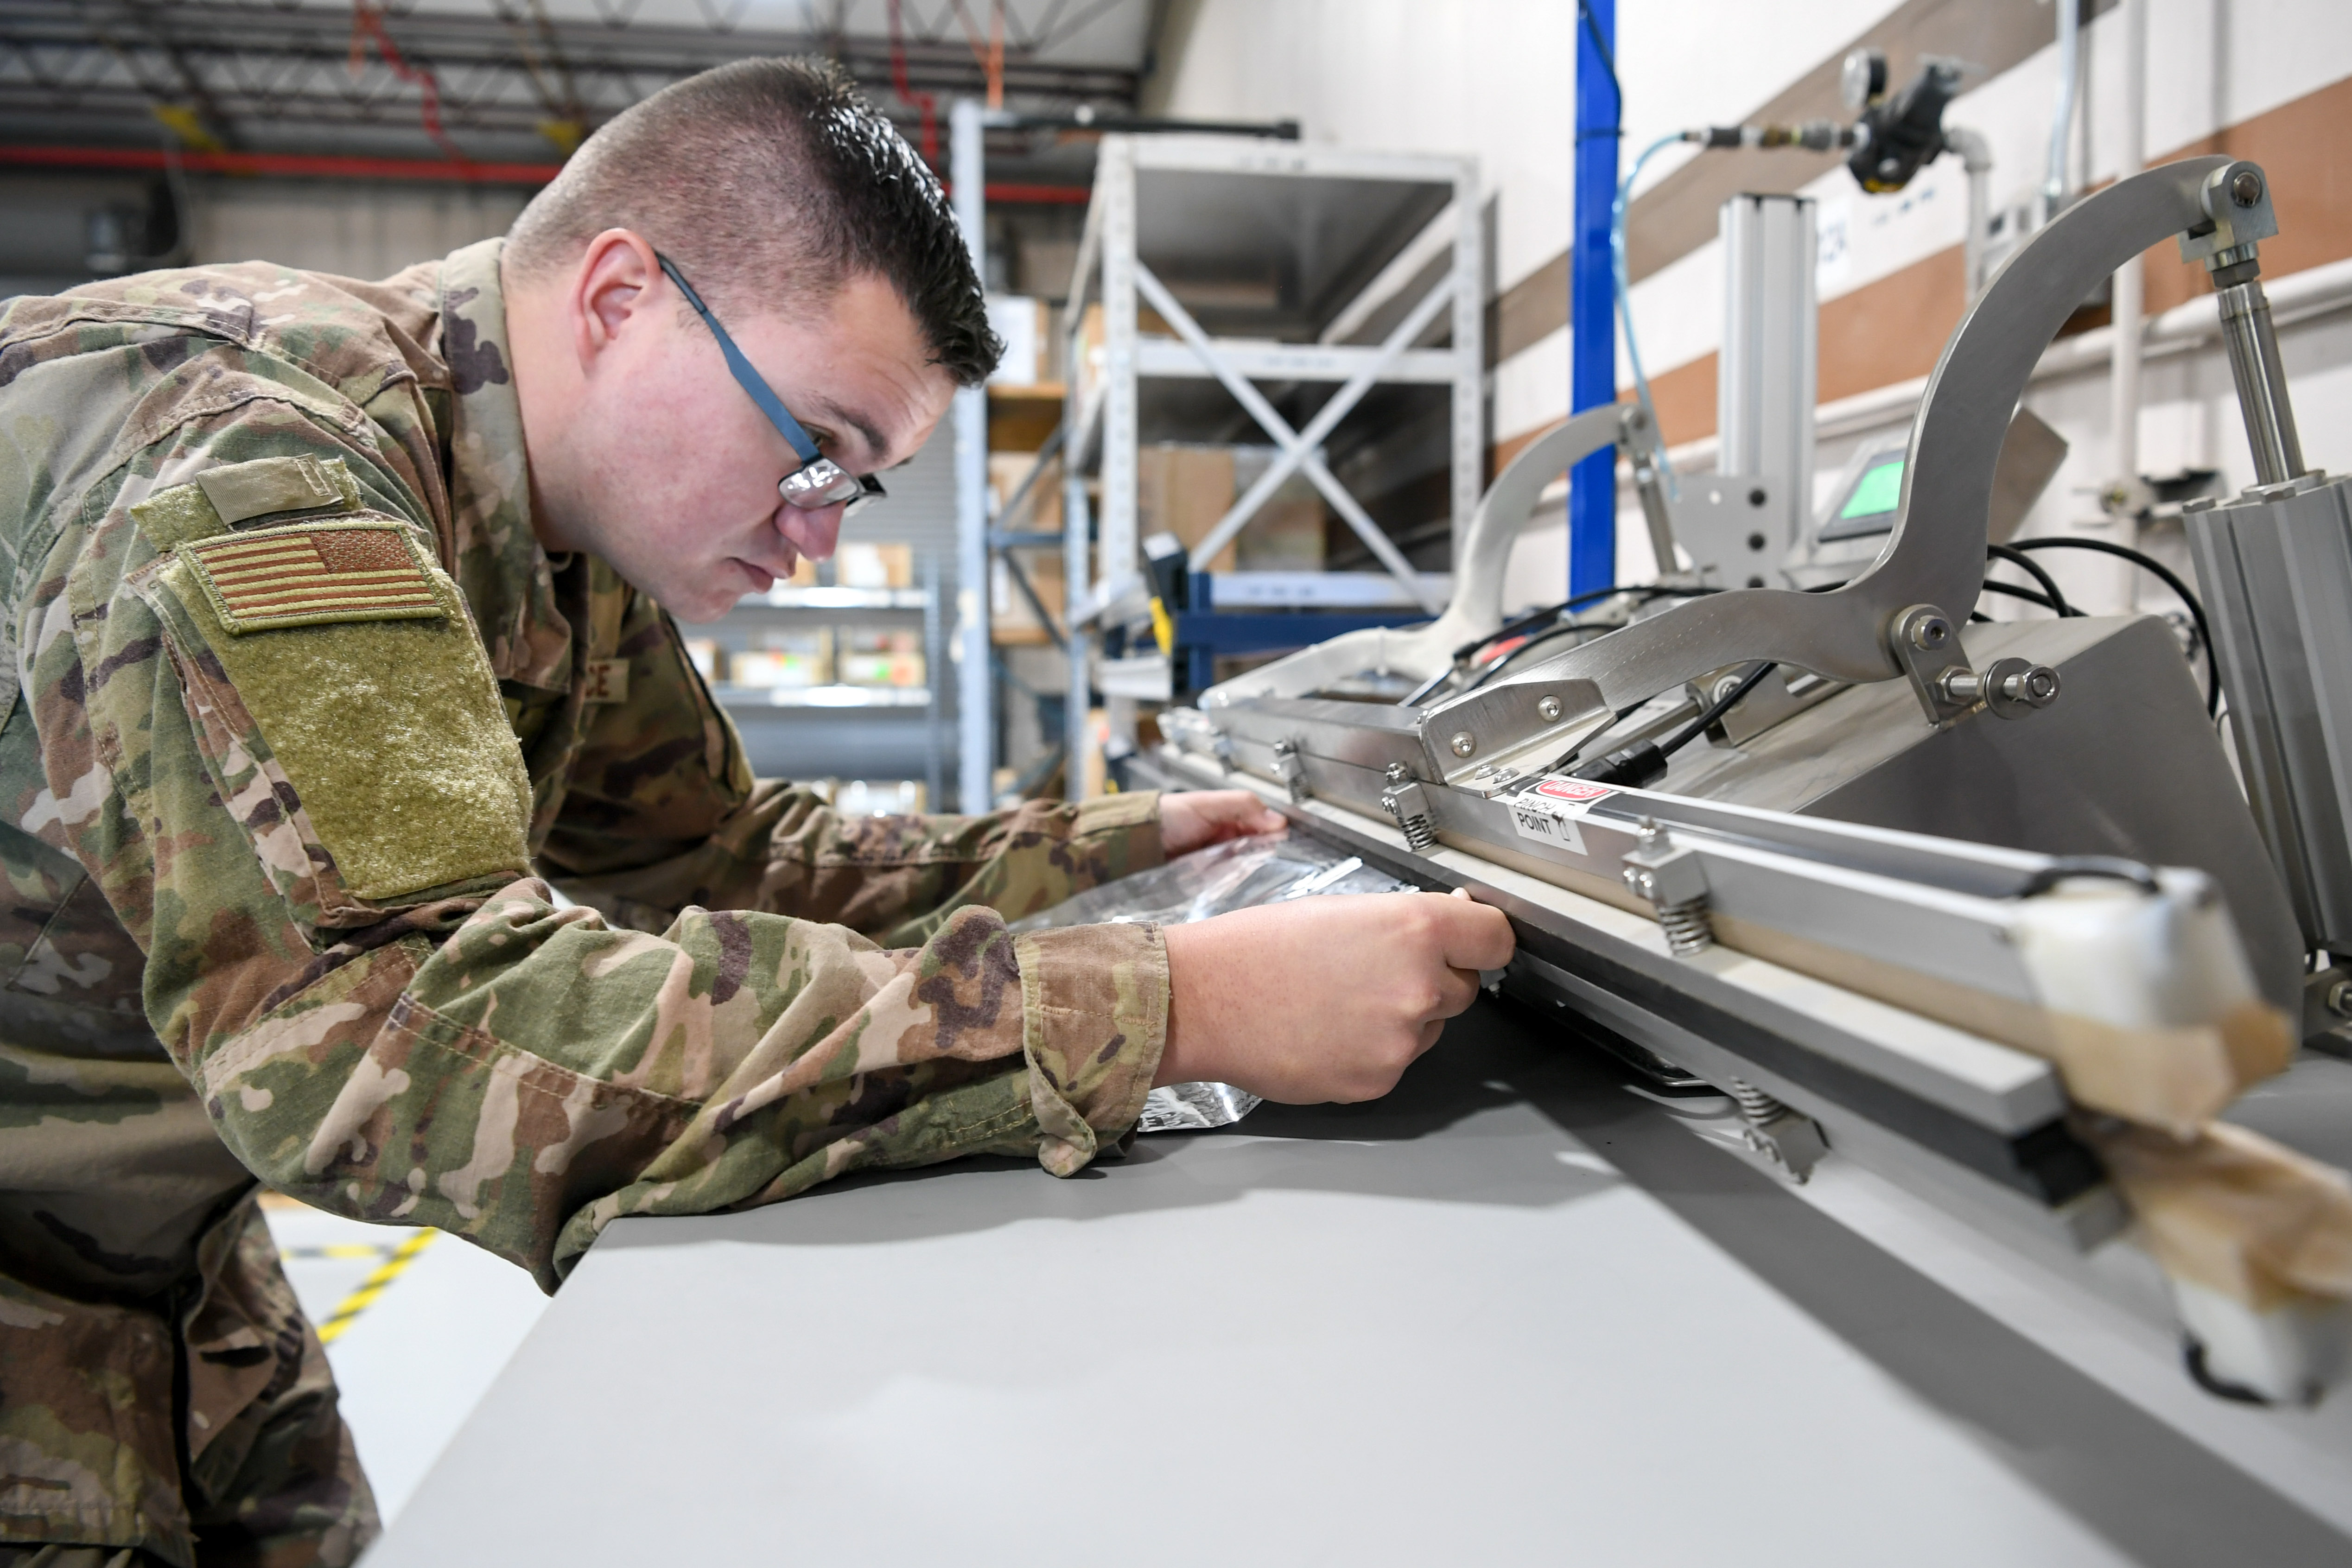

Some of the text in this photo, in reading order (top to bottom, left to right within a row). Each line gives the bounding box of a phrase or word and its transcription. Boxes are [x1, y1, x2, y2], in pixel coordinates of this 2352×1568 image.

[1543, 781, 1603, 797] DANGER
[1513, 798, 1556, 815] PINCH
[1517, 812, 1551, 835] POINT
